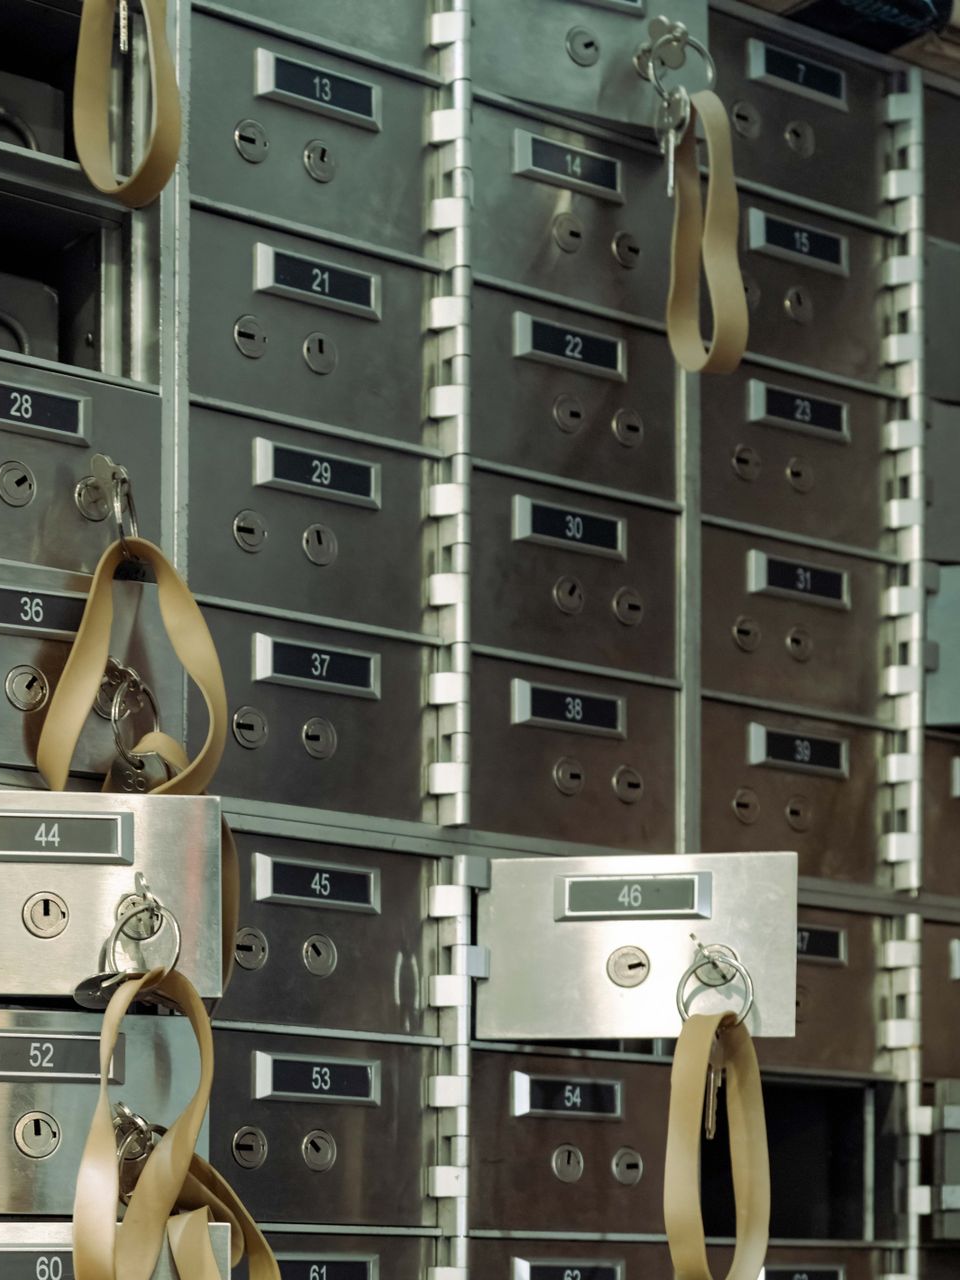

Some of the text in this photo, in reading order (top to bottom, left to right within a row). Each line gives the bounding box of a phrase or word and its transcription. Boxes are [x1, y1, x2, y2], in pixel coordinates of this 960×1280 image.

[313, 77, 331, 102] 13
[565, 155, 581, 175] 14
[794, 232, 808, 253] 15
[311, 269, 328, 293] 21
[565, 335, 582, 359] 22
[9, 393, 31, 419] 28
[795, 400, 810, 421] 23
[311, 460, 330, 485] 29
[565, 516, 582, 539] 30
[797, 569, 810, 589] 31
[20, 597, 43, 623] 36
[311, 653, 330, 677] 37
[565, 697, 582, 720] 38
[795, 740, 810, 761] 39
[34, 823, 60, 847] 44
[310, 873, 330, 896] 45
[617, 885, 641, 907] 46
[29, 1043, 53, 1068] 52
[311, 1067, 330, 1090] 53
[564, 1086, 581, 1107] 54
